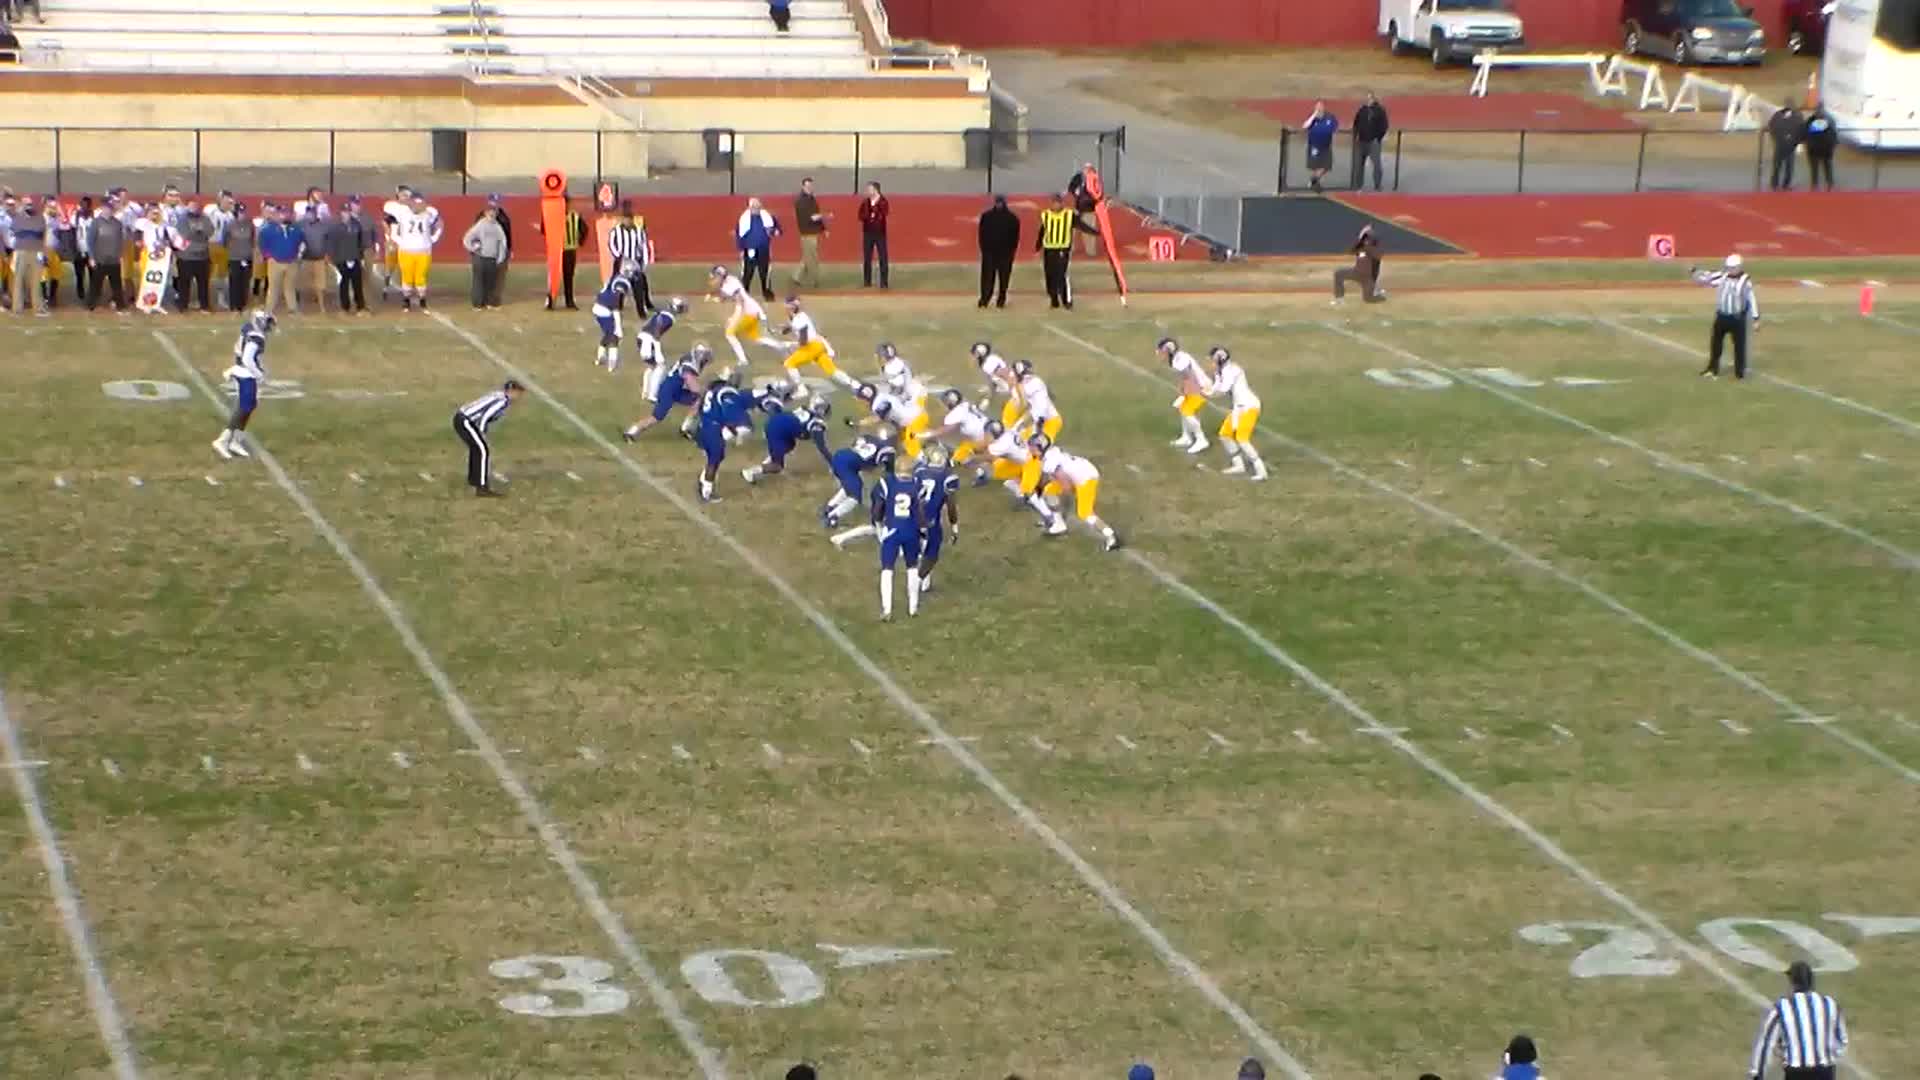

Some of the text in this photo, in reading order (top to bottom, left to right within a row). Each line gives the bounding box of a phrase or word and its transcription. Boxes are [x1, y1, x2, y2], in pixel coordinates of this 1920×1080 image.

[1153, 239, 1171, 258] 10
[1655, 238, 1672, 257] G
[918, 479, 936, 502] 7
[893, 493, 912, 518] 2
[1517, 916, 1860, 978] 20
[488, 948, 826, 1018] 30
